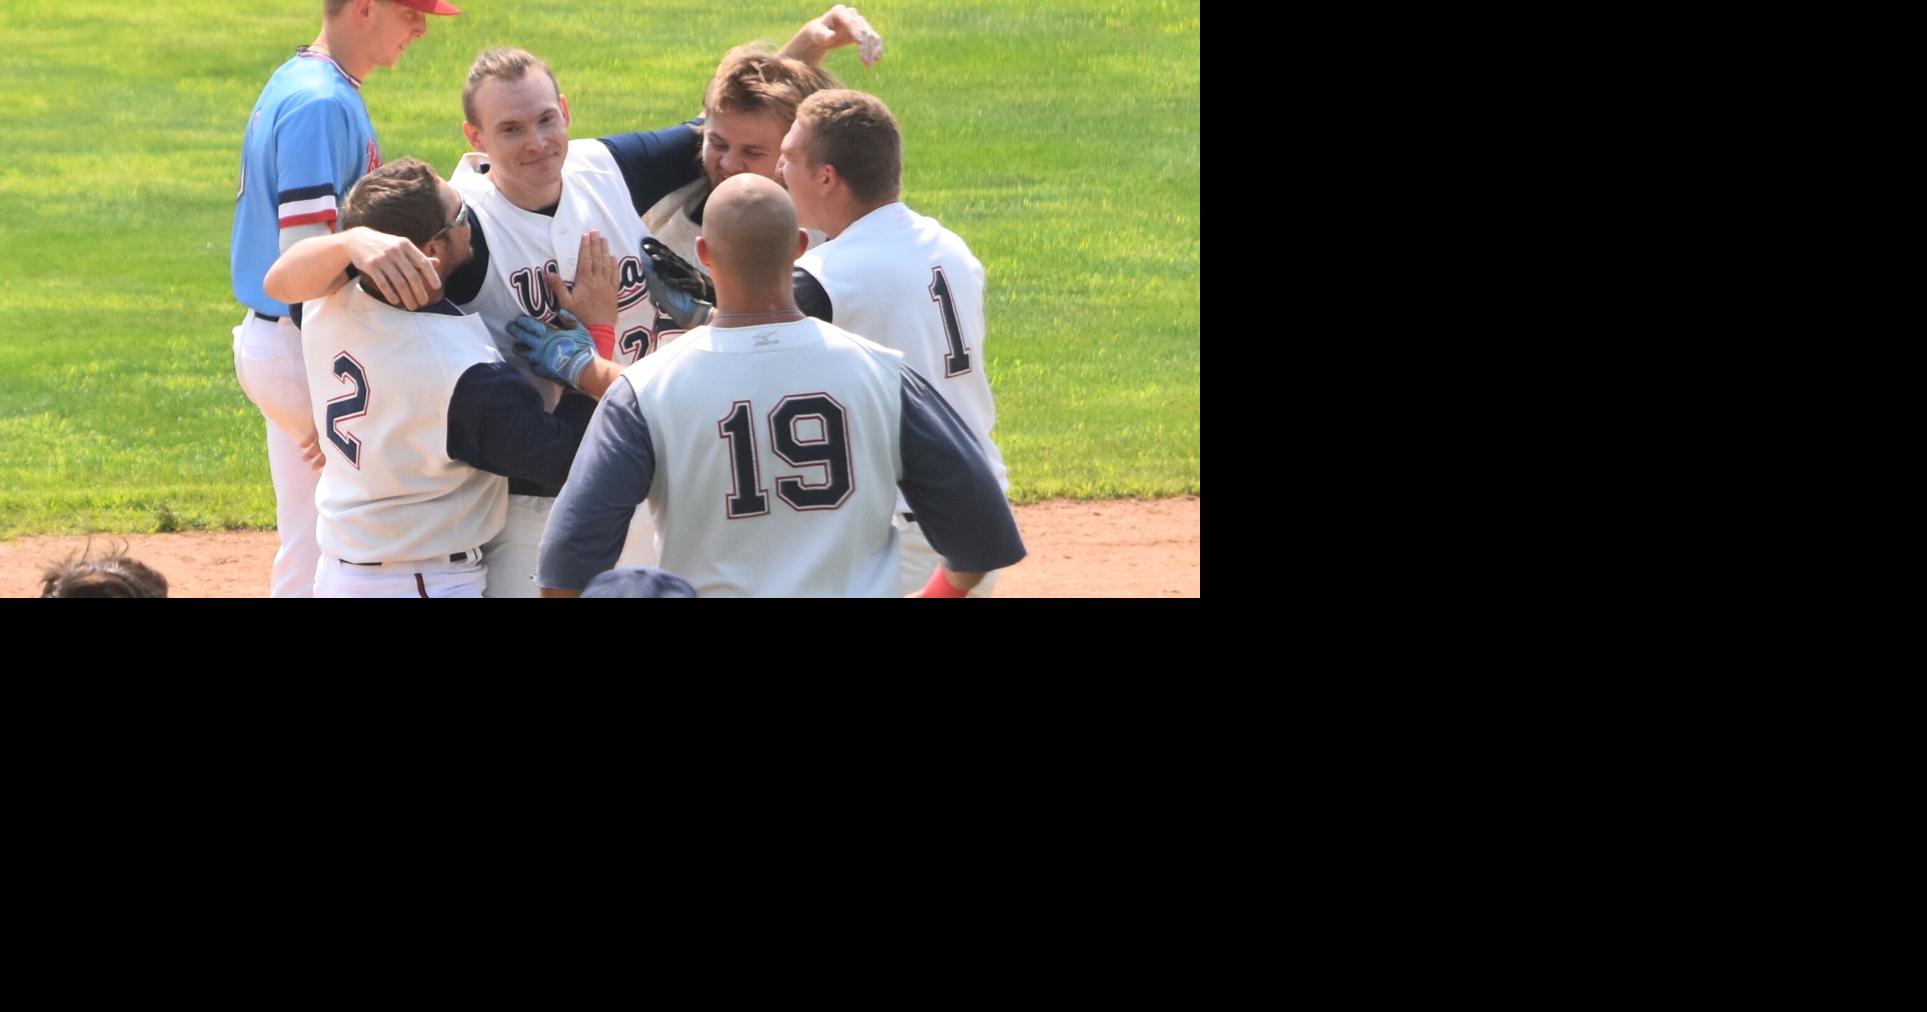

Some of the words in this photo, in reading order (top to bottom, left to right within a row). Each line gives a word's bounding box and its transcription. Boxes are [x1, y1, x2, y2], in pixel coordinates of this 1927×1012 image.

[928, 265, 972, 379] 1
[326, 350, 371, 471] 2
[717, 391, 856, 519] 19
